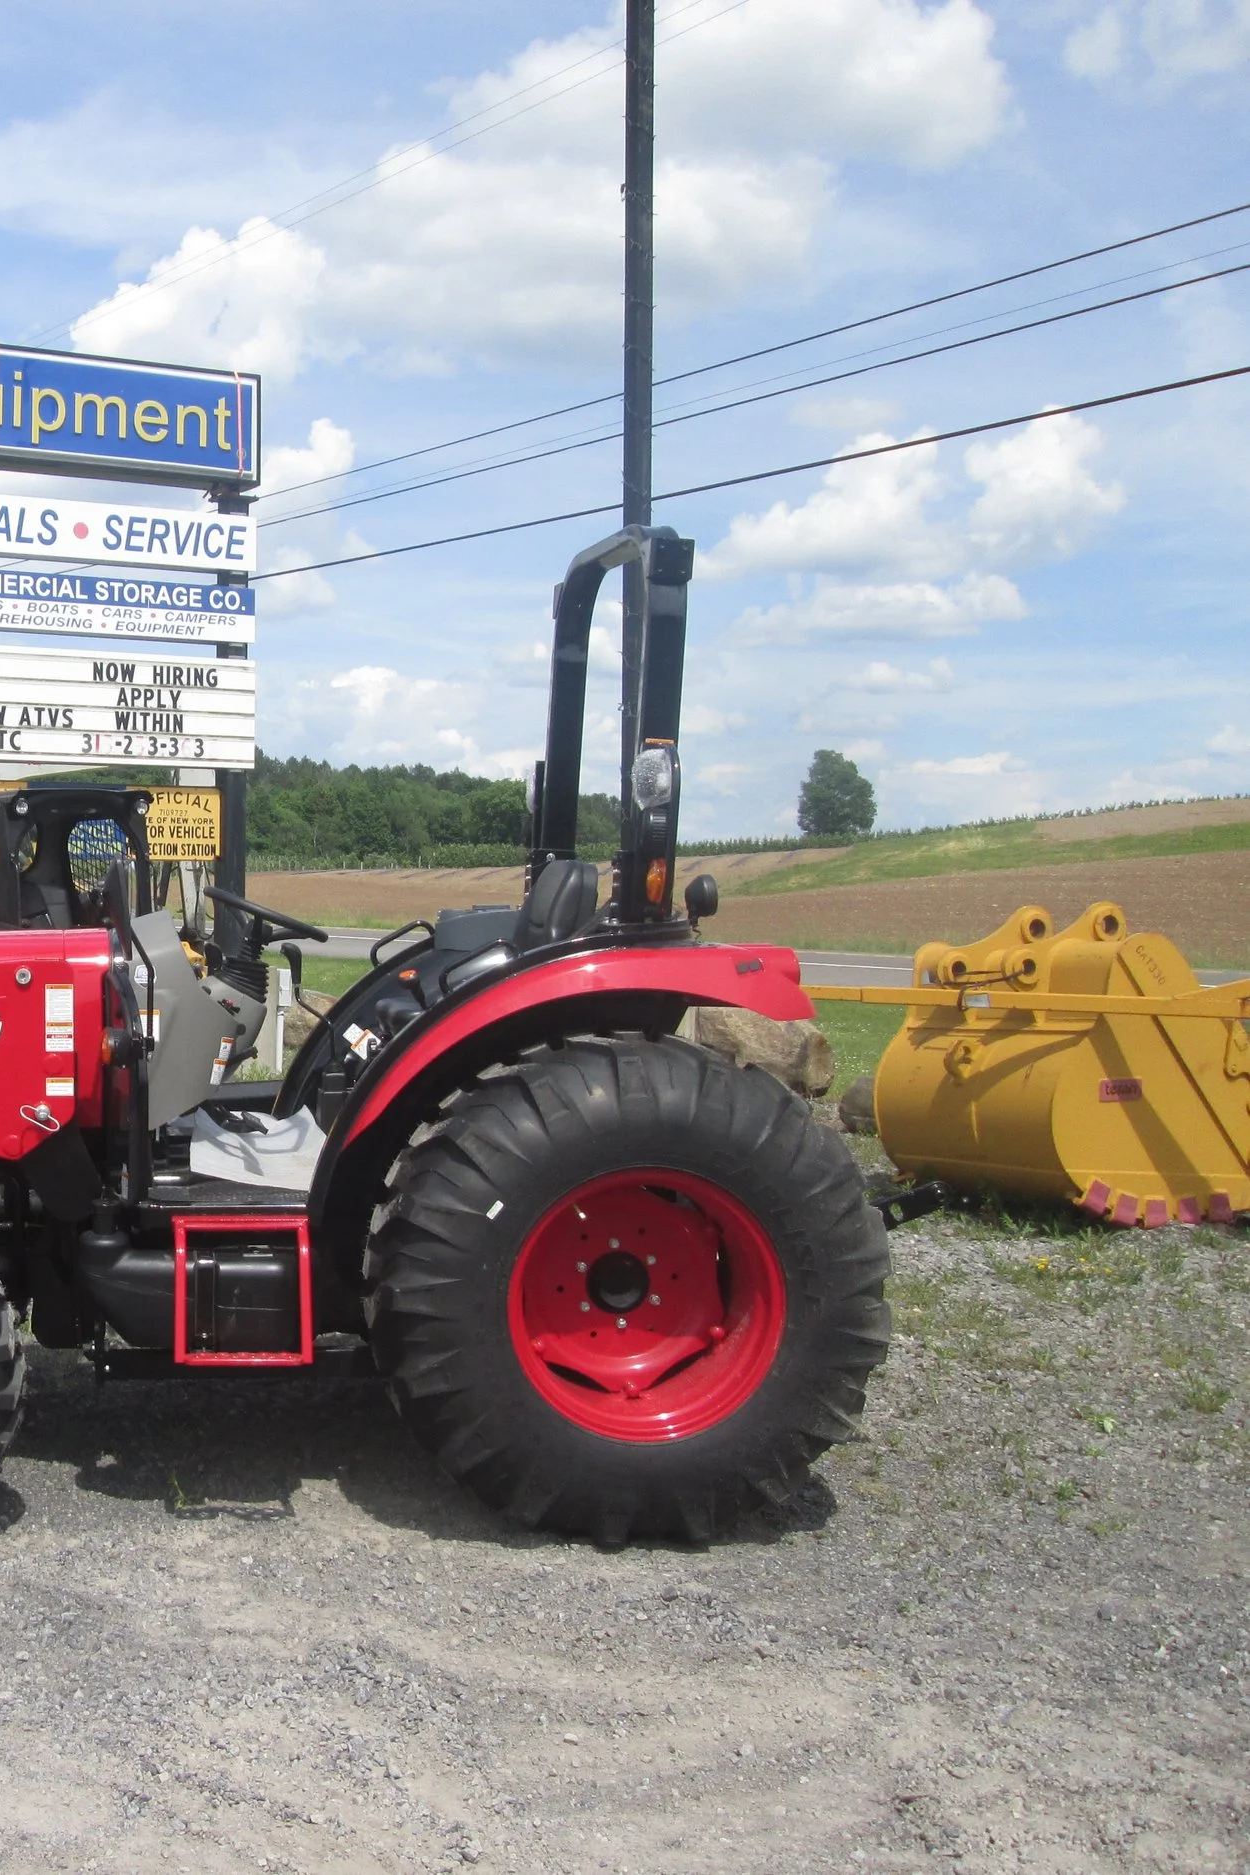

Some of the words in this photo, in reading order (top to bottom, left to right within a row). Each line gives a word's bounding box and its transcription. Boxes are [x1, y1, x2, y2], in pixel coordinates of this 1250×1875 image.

[102, 514, 247, 560] SERVICE
[95, 580, 202, 608] STORAGE
[209, 590, 246, 611] CO.
[27, 602, 79, 615] BOATS
[101, 607, 143, 620] CARS
[164, 613, 237, 626] CAMPERS
[115, 621, 205, 636] EQUIPMENT
[93, 661, 136, 683] NOW
[153, 665, 218, 688] HIRING
[116, 687, 182, 709] APPLY
[19, 706, 74, 728] ATVS
[115, 711, 184, 733] WITHIN
[155, 791, 212, 813] FICIAL
[157, 816, 168, 824] OF
[192, 817, 214, 825] YORK
[169, 825, 215, 839] VEHICLE
[180, 843, 216, 857] STATION
